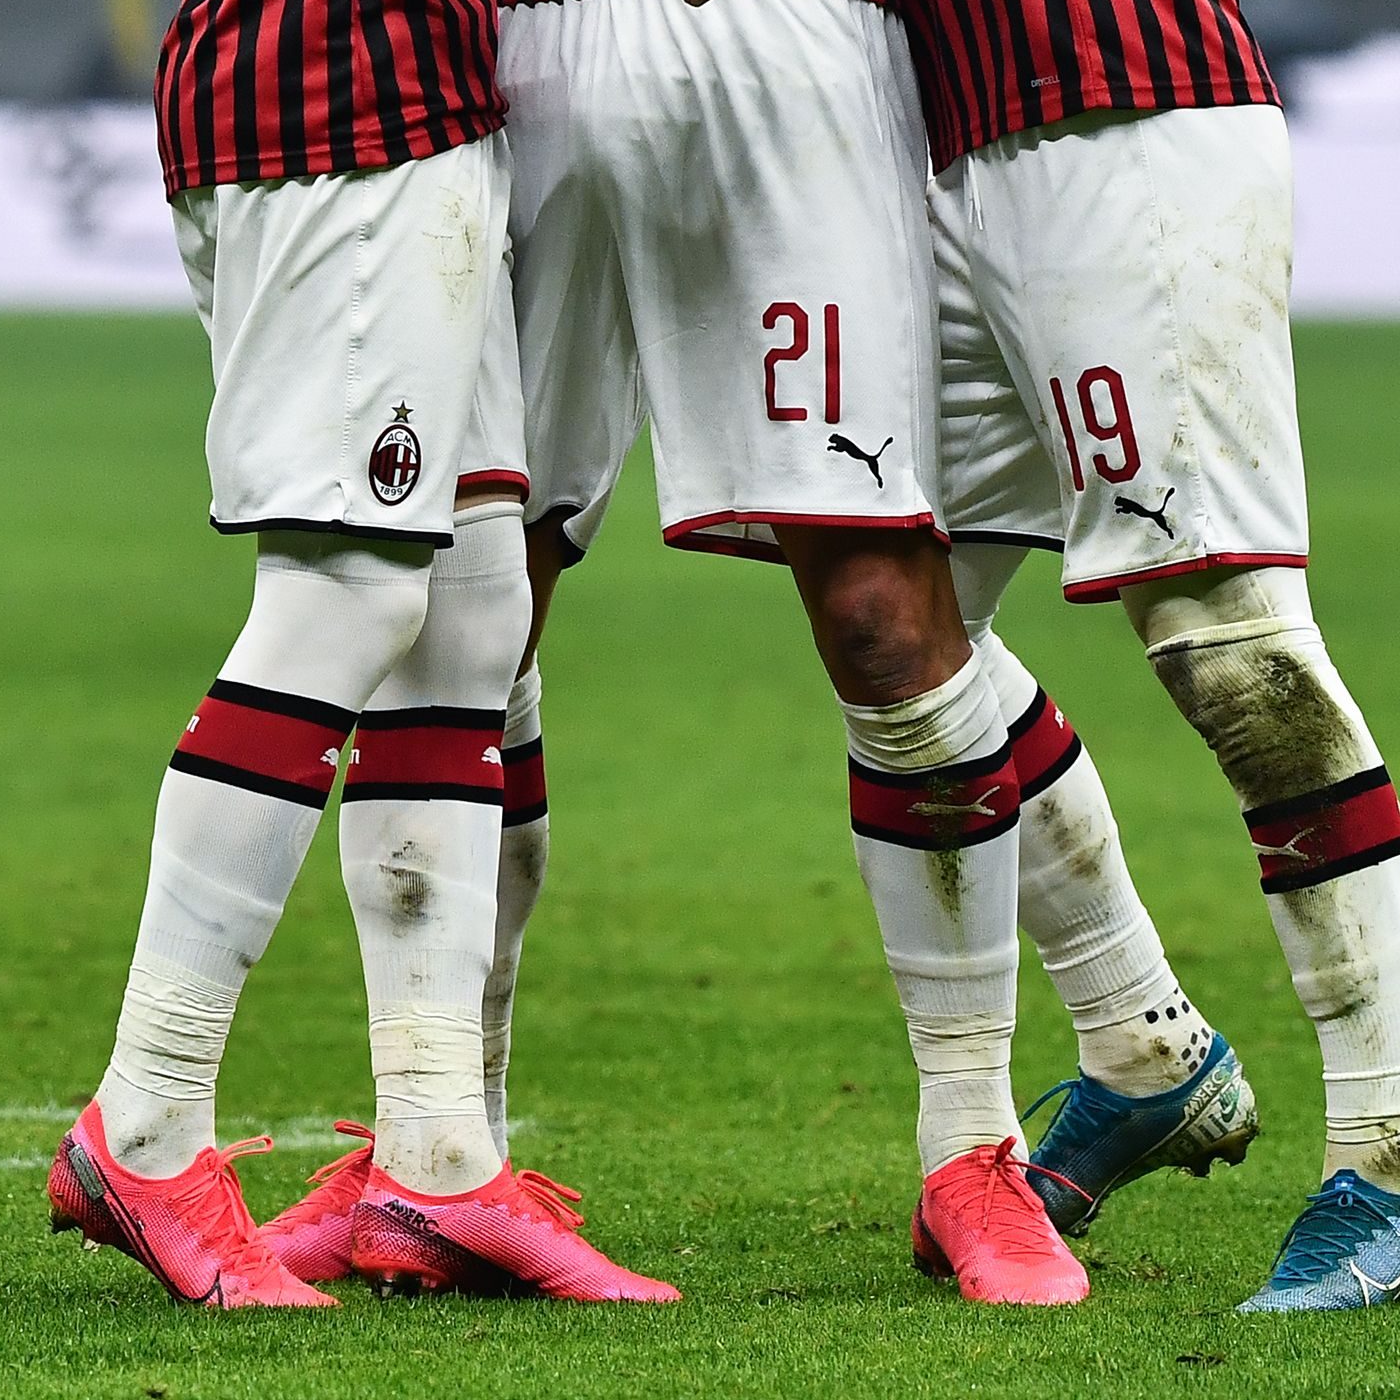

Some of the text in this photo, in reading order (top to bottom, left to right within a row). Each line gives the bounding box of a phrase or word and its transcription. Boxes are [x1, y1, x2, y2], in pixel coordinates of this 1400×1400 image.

[761, 300, 842, 426] 21
[384, 430, 413, 448] ACM
[1048, 364, 1143, 493] 19
[379, 485, 404, 497] 1899
